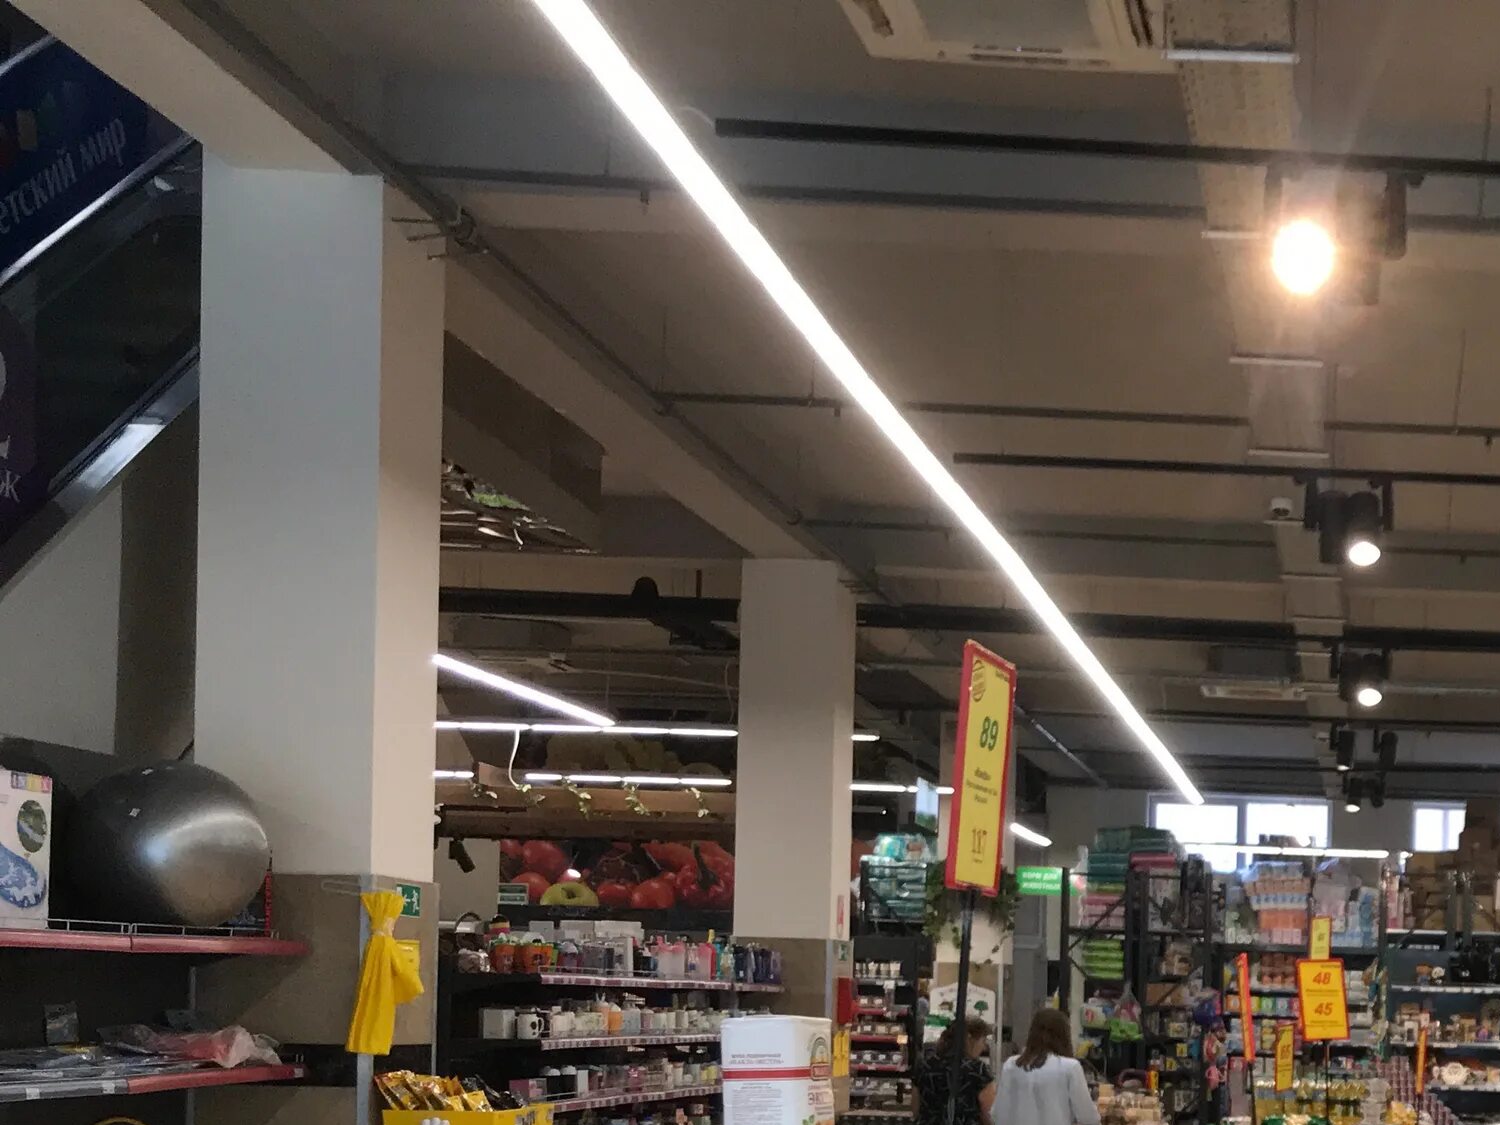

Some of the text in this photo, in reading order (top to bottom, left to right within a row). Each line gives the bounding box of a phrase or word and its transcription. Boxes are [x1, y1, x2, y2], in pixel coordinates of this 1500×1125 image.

[979, 715, 999, 752] 89
[1312, 971, 1331, 985] 48
[1314, 1002, 1333, 1017] 45
